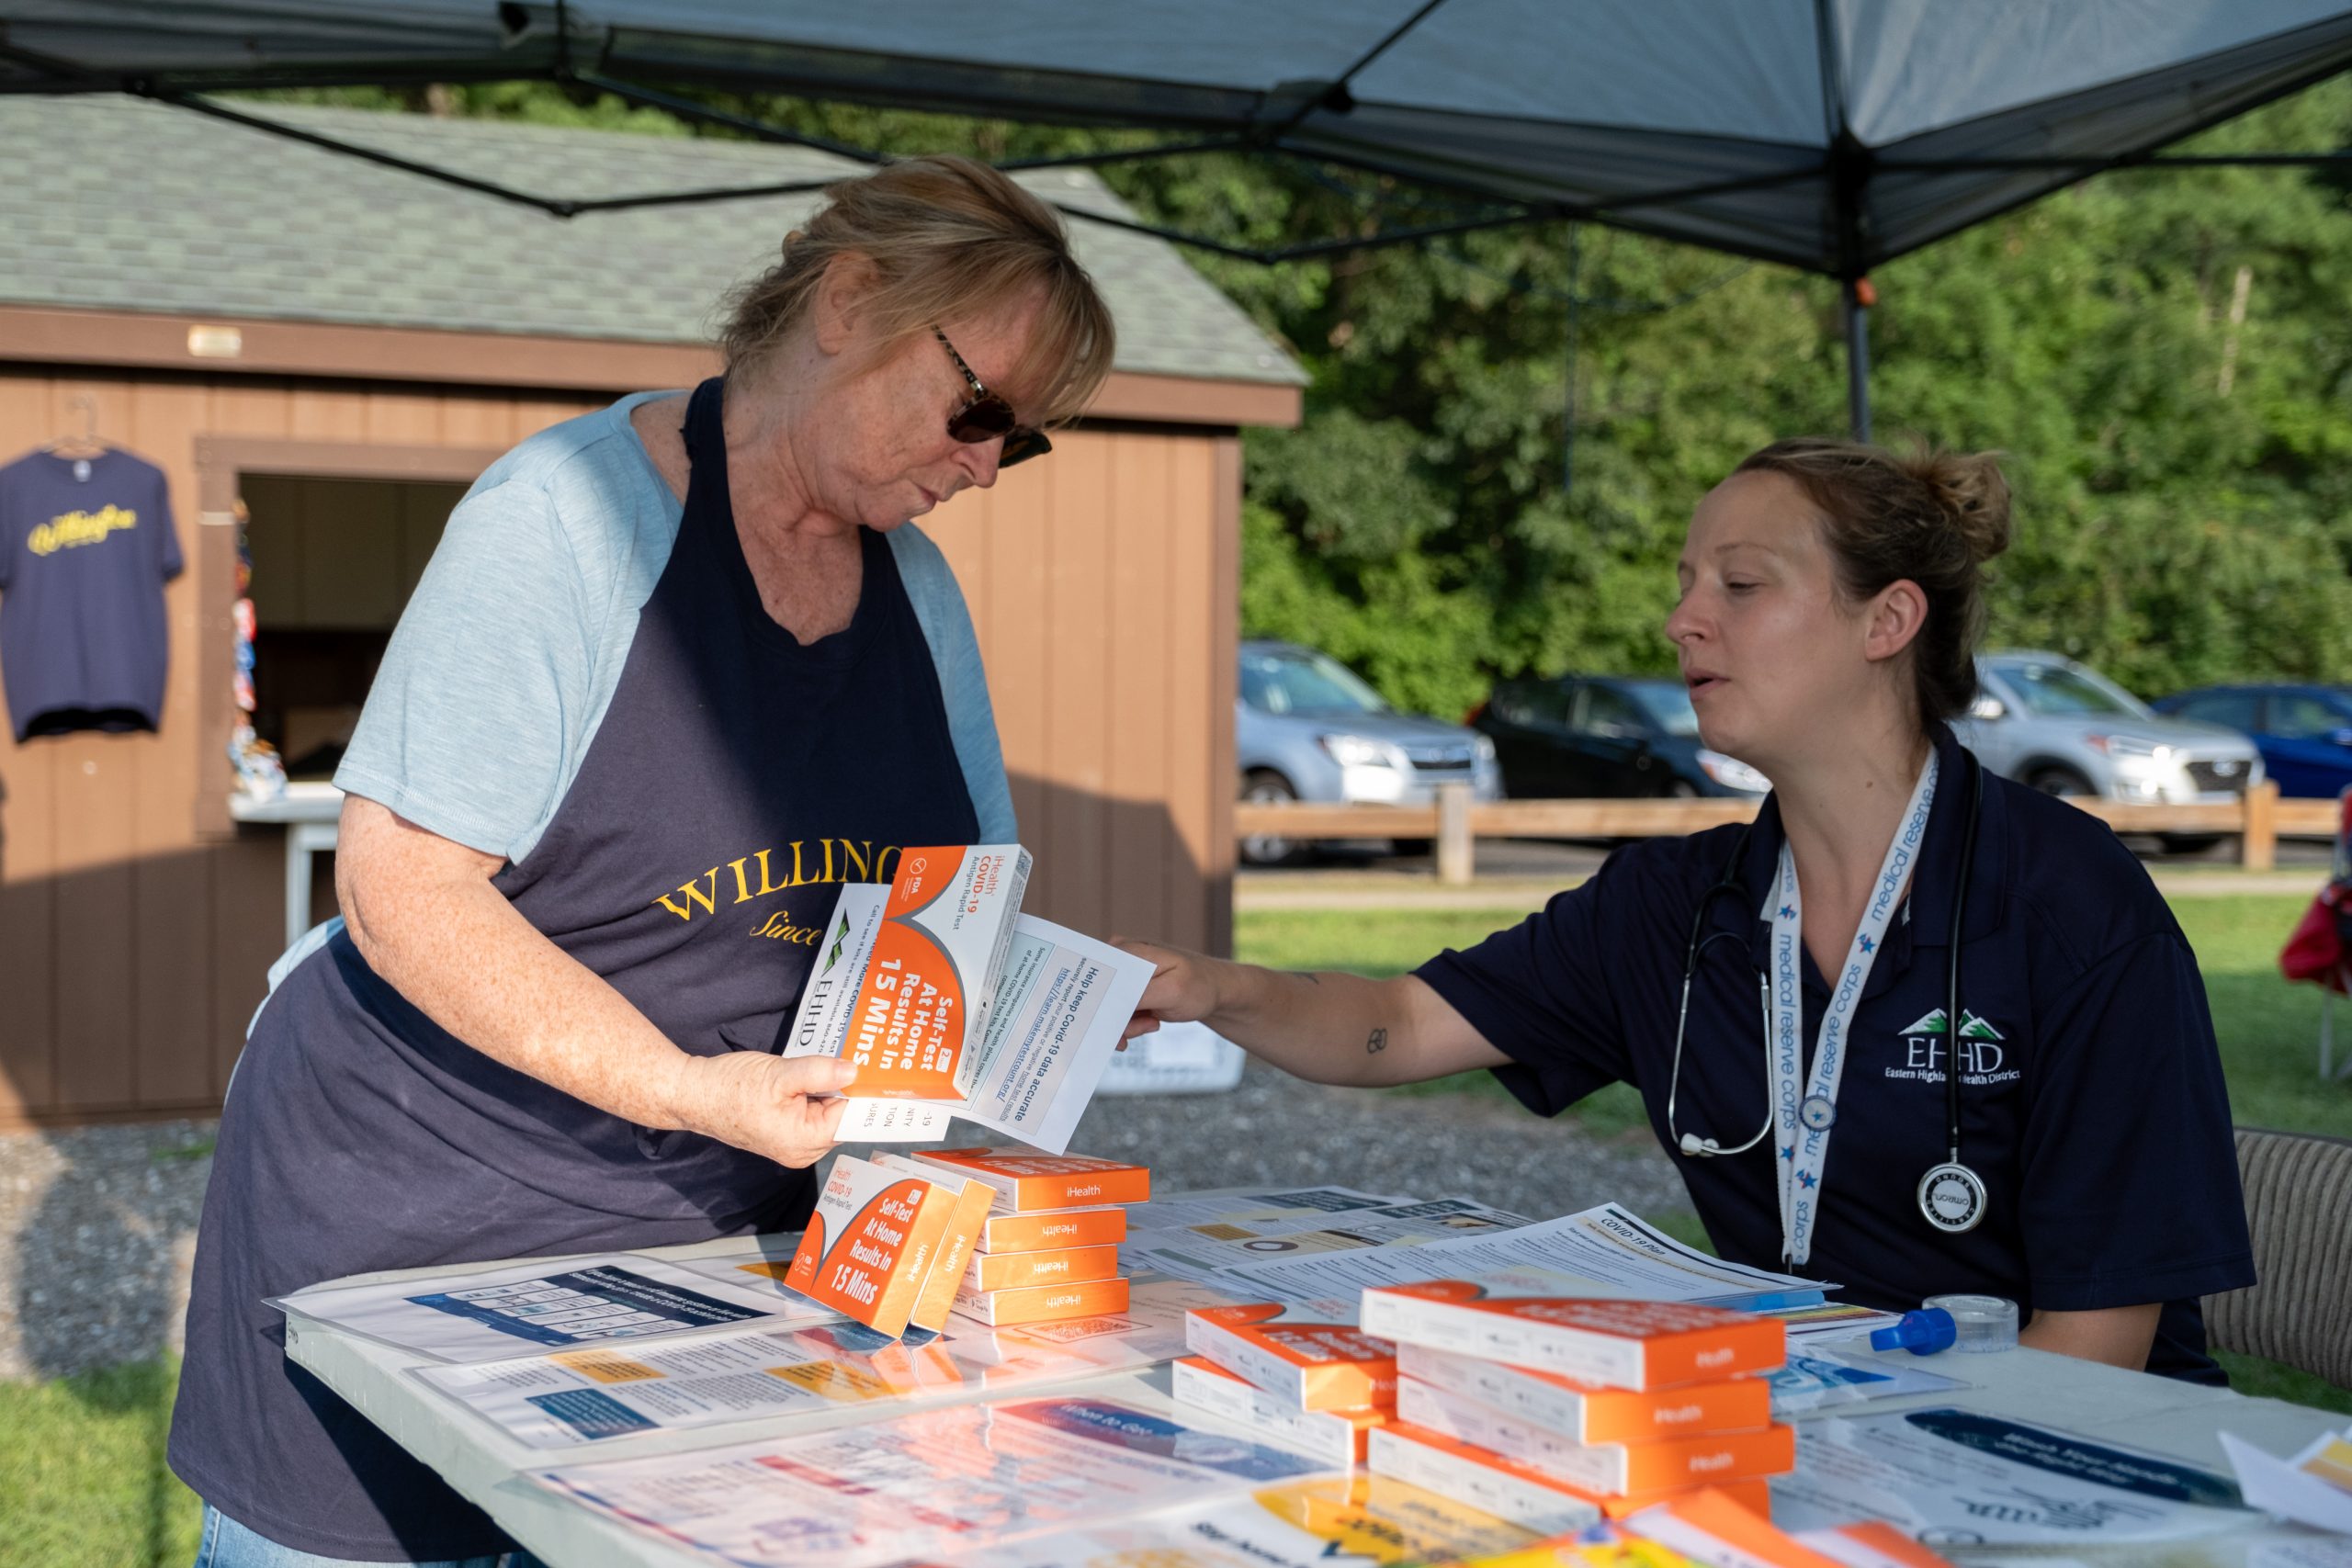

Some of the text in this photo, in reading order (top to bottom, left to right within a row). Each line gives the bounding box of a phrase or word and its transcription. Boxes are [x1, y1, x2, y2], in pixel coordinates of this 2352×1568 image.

[910, 875, 922, 895] FDA
[967, 854, 991, 914] COVID-19
[984, 853, 1005, 897] iHealth
[1871, 845, 1910, 922] medical
[952, 855, 979, 931] Antigen Rapid Test
[866, 918, 873, 927] to
[869, 903, 879, 918] Call
[749, 910, 823, 946] Since
[1033, 946, 1045, 963] Some
[1020, 961, 1037, 988] insurance
[1069, 955, 1087, 983] securely
[829, 988, 843, 1021] available
[918, 982, 938, 1007] At
[1004, 987, 1023, 1018] companies
[1060, 982, 1074, 1002] report
[797, 976, 832, 1048] EHHD
[837, 987, 859, 1033] COVID-19
[852, 954, 902, 1069] 15 Mins
[886, 971, 921, 1047] Results
[994, 1004, 1004, 1017] test
[1053, 1001, 1064, 1016] your
[1819, 1014, 1841, 1076] reserve
[1835, 963, 1862, 1013] corps
[920, 995, 953, 1072] Self-Test
[996, 966, 1070, 1103] https://learn.makemytestcount.org/
[1000, 1017, 1009, 1028] and
[1042, 1015, 1057, 1038] positive
[1778, 933, 1796, 1130] medical reserve corps
[829, 1032, 841, 1054] Test
[899, 1008, 931, 1072] Home
[989, 1028, 1002, 1046] health
[1013, 965, 1099, 1122] Help keep Covid-19 data accurate
[878, 1048, 899, 1071] In
[981, 1046, 993, 1063] plans
[1024, 1044, 1042, 1071] negative
[974, 1062, 985, 1078] cover
[1016, 1070, 1029, 1089] home
[1884, 1066, 1916, 1078] Eastern
[1988, 1069, 2020, 1084] District
[1011, 1089, 1021, 1101] test
[1000, 1100, 1014, 1122] results
[828, 1180, 853, 1196] COVID-19
[1067, 1186, 1101, 1198] iHealth
[834, 1198, 846, 1209] Rapid
[844, 1201, 853, 1211] Test
[879, 1197, 914, 1224] Self-Test
[863, 1217, 903, 1247] At Home
[1042, 1224, 1078, 1236] iHealth
[1793, 1200, 1811, 1250] corps
[849, 1238, 892, 1271] Results In
[908, 1244, 930, 1282] iHealth
[944, 1234, 967, 1273] iHealth
[1033, 1261, 1069, 1274] iHealth
[831, 1263, 847, 1290] 15
[843, 1269, 879, 1305] Mins
[1046, 1295, 1081, 1308] iHealth
